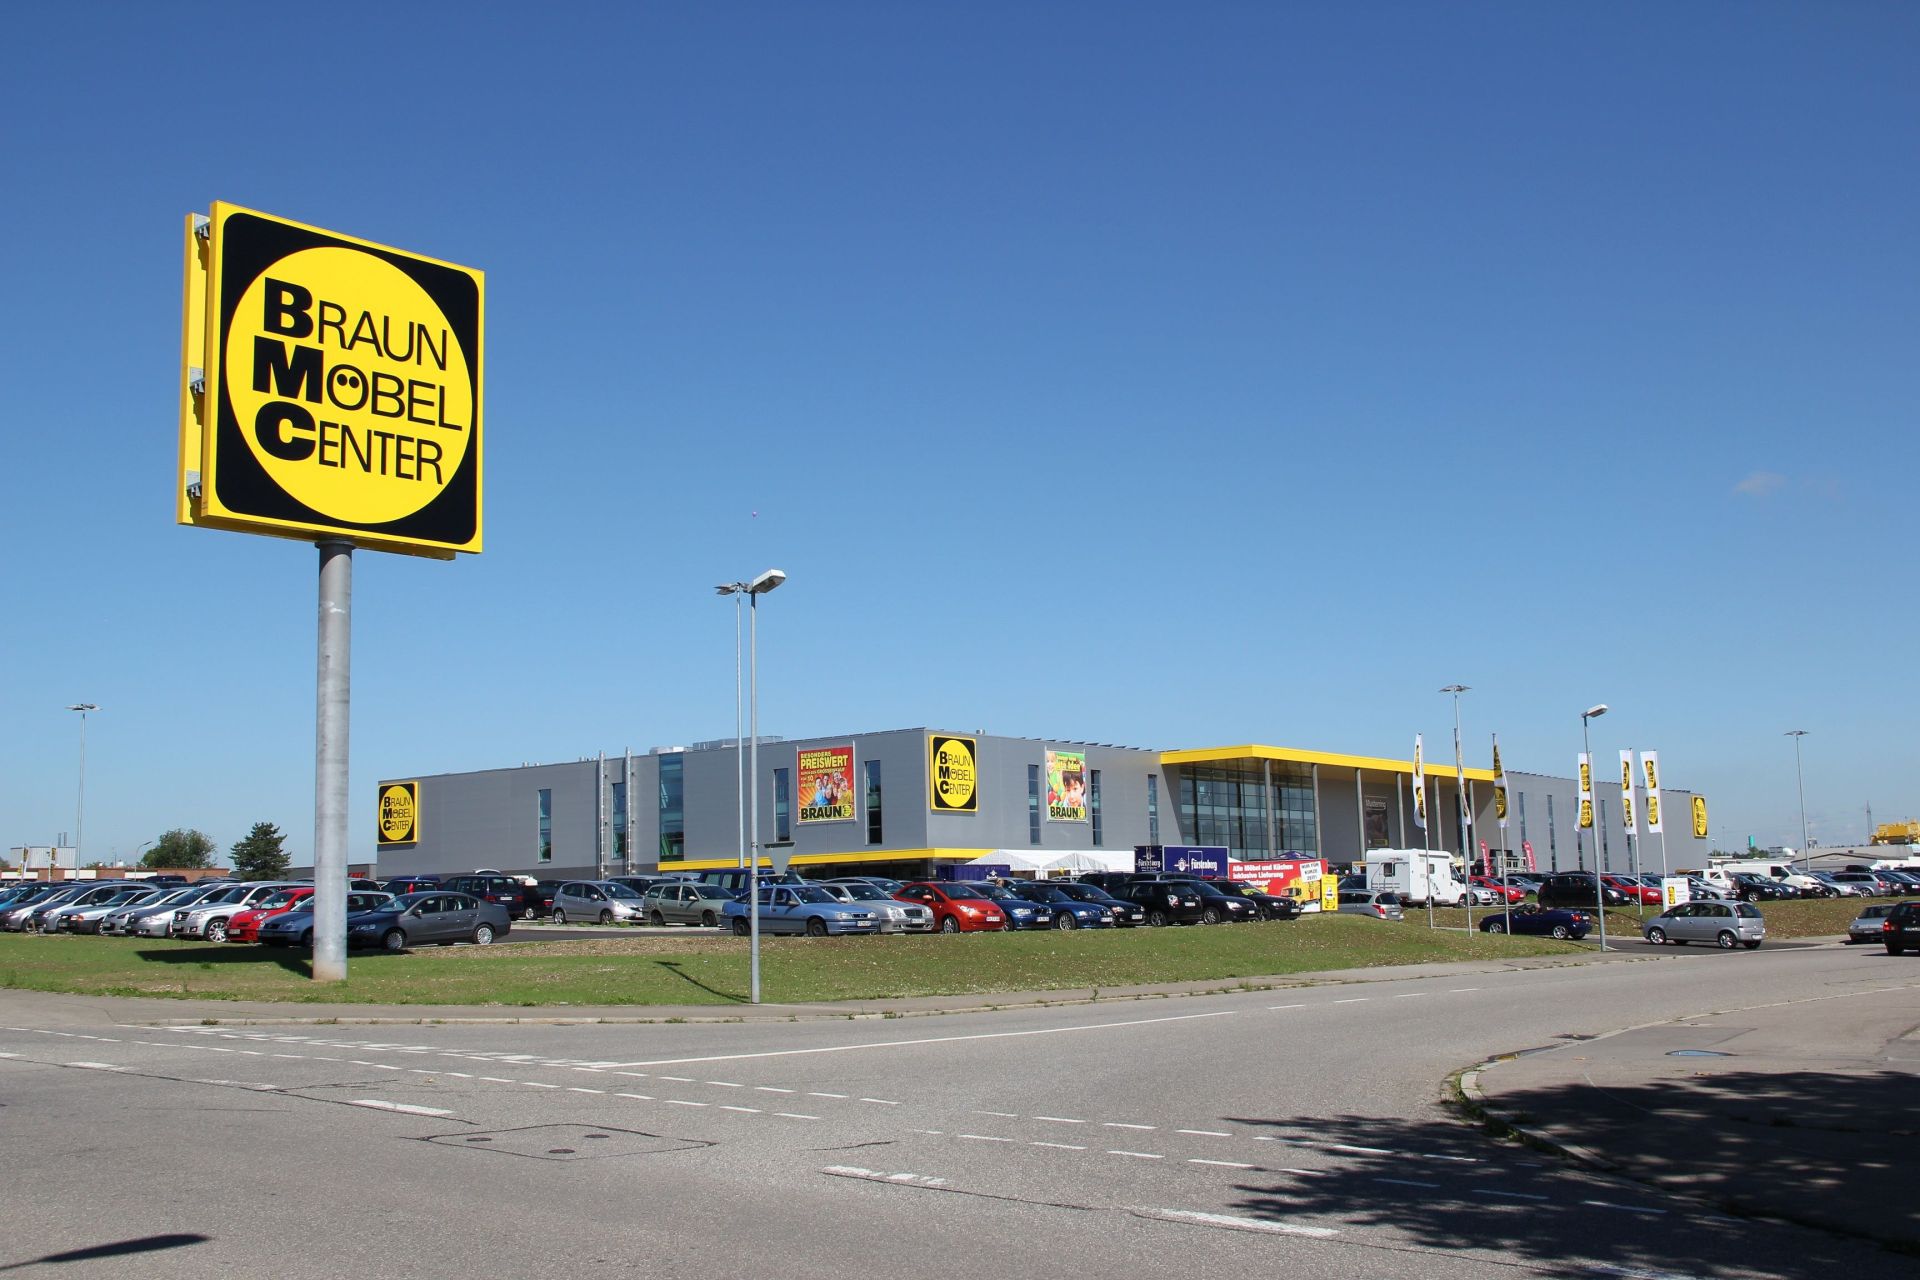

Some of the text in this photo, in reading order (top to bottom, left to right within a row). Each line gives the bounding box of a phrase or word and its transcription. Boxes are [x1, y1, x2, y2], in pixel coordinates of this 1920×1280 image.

[264, 277, 447, 371] BRAUN
[252, 335, 463, 431] MÖBEL
[255, 401, 443, 485] CENTER
[801, 755, 848, 770] PREISWERT
[940, 751, 970, 766] BRAUN
[938, 766, 973, 781] MÖBEL
[940, 780, 971, 796] CENTER
[384, 797, 410, 807] BRAUN
[383, 808, 412, 819] MÖBEL
[801, 806, 842, 820] BRAUN
[1050, 806, 1079, 818] BRAUN
[384, 820, 410, 831] CENTER
